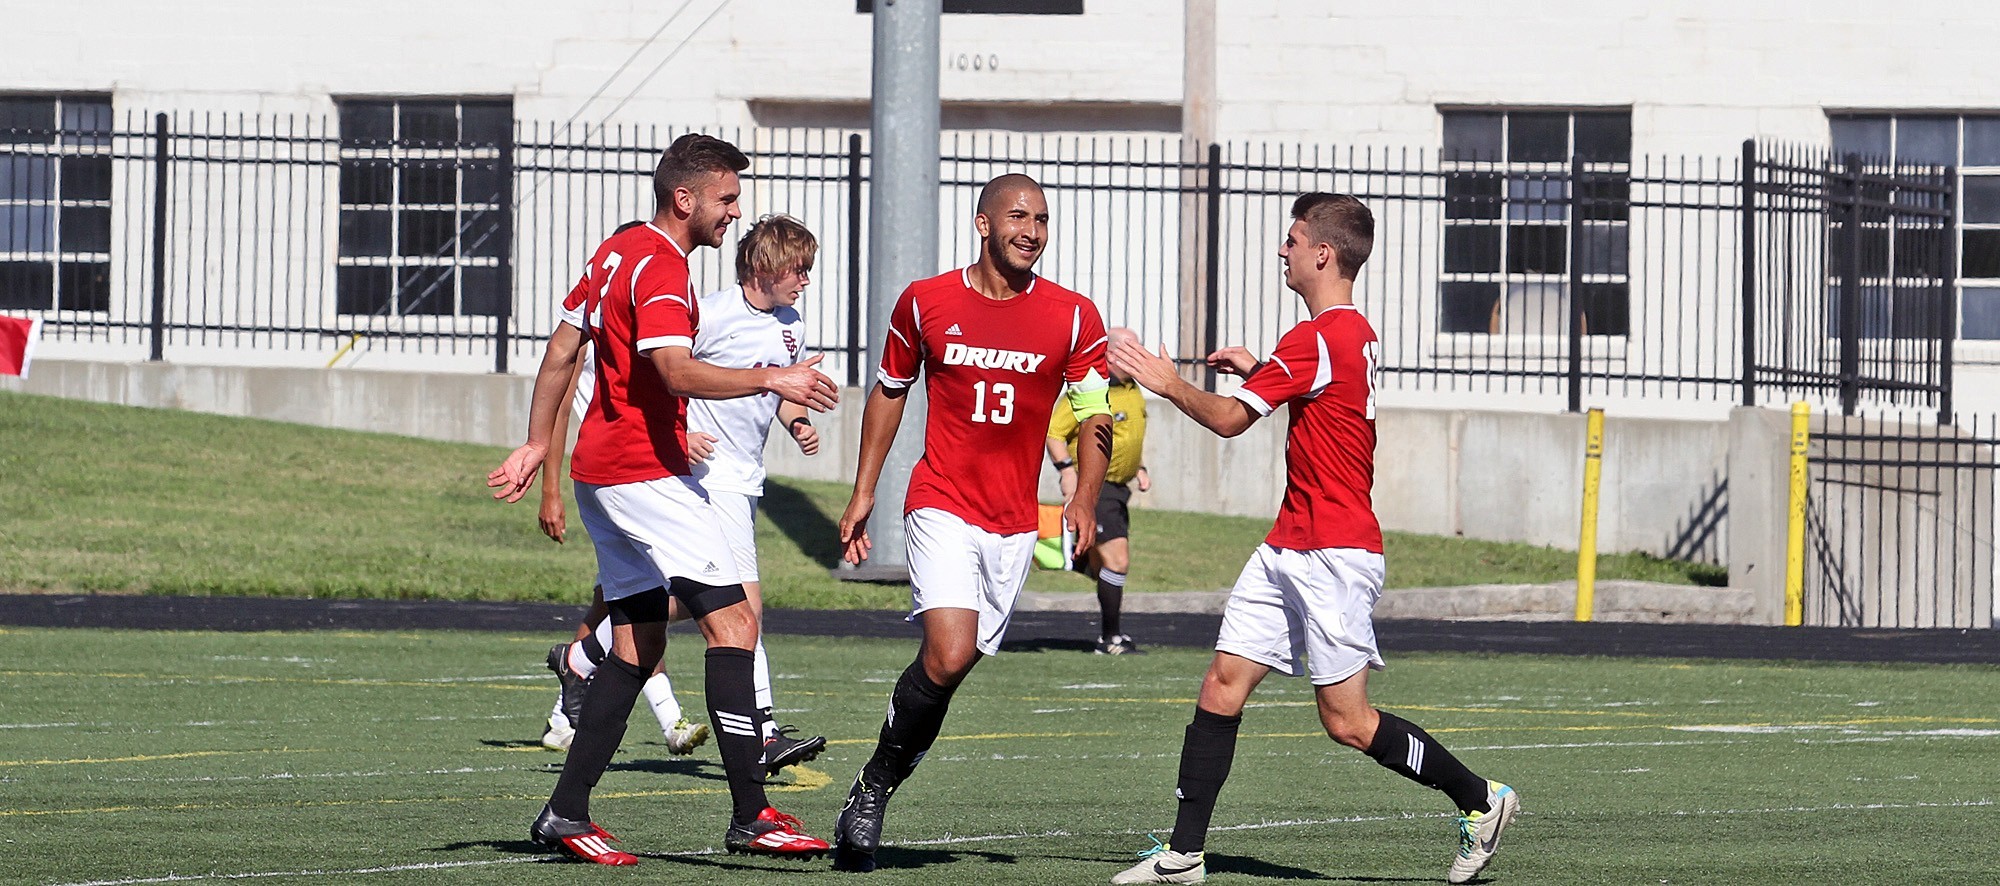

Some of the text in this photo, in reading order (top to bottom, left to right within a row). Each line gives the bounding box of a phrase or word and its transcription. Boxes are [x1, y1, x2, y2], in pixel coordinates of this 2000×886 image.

[948, 53, 998, 71] 1000
[942, 342, 1047, 374] DRURY
[971, 380, 1015, 424] 13
